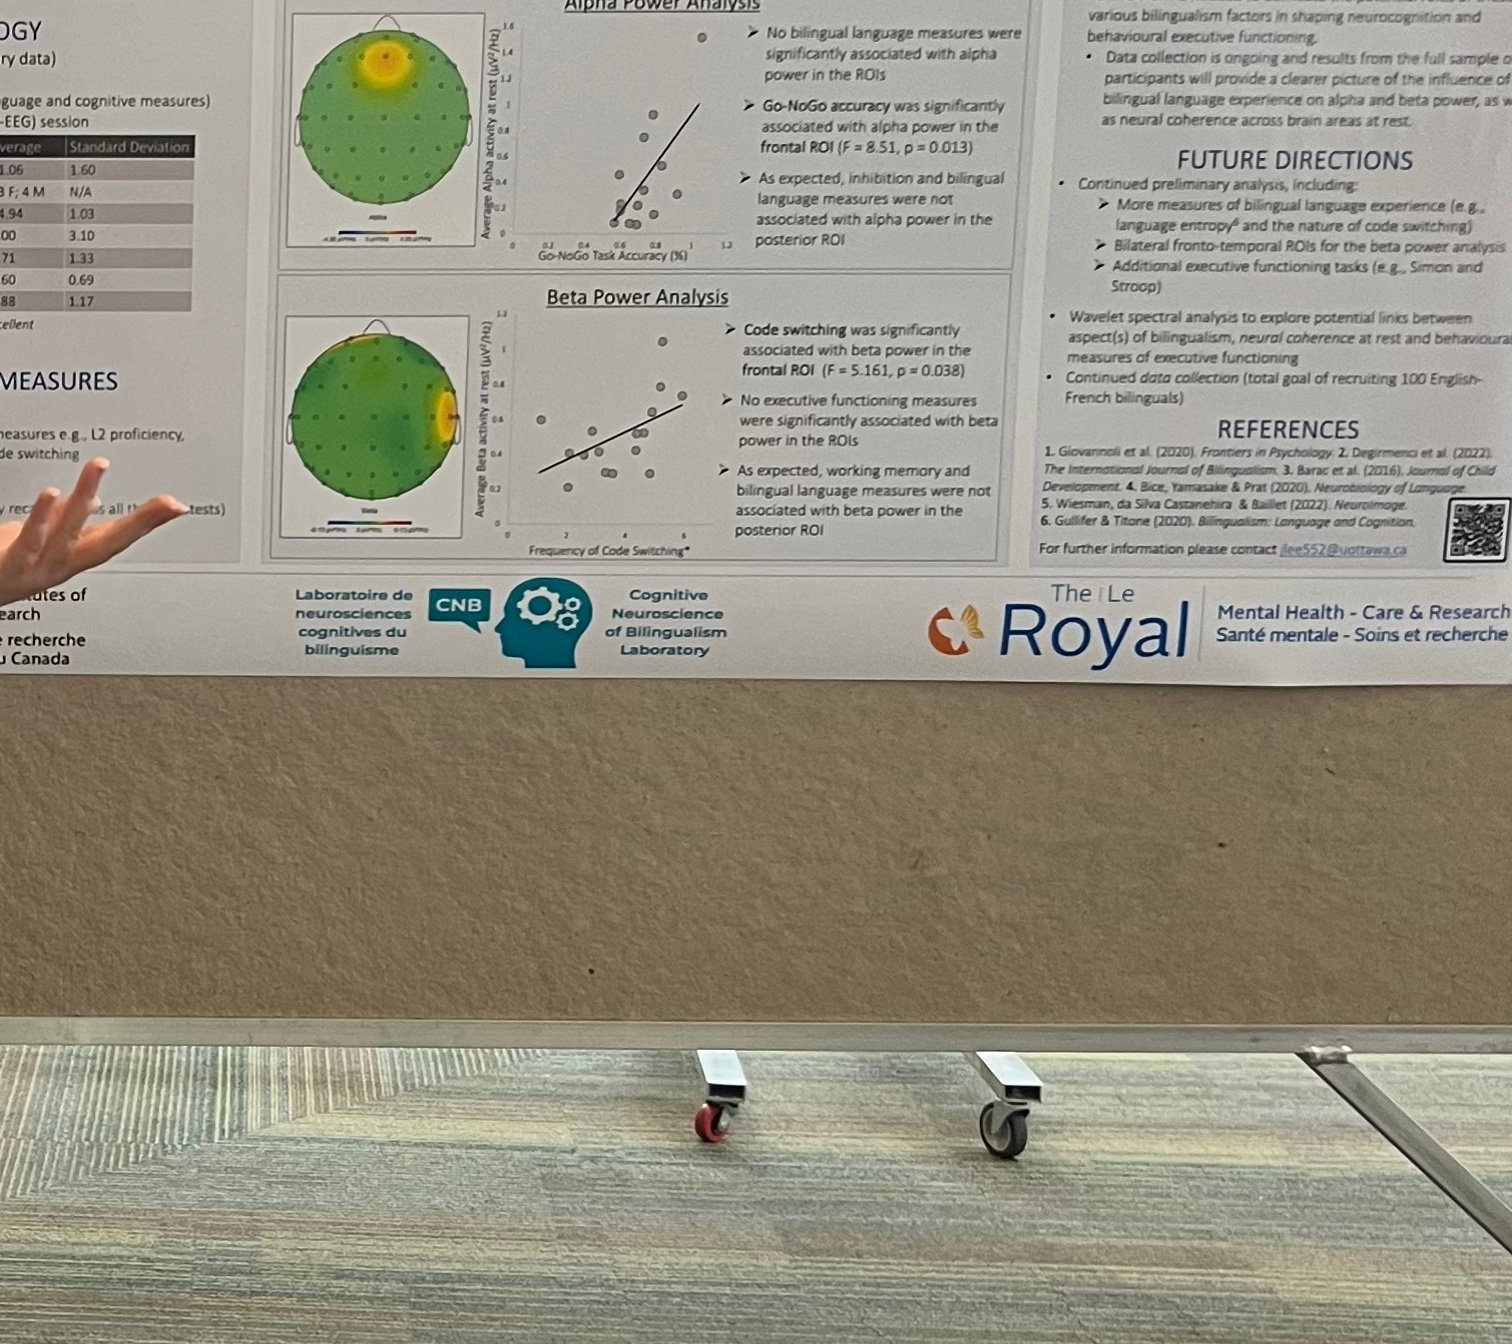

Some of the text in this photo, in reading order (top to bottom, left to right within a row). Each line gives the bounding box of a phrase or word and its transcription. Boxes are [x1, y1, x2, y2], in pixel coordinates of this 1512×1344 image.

[70, 140, 190, 153] Standard Deviation
[1178, 150, 1413, 170] FUTURE DIRECTIONS
[548, 288, 728, 307] Beta Power Analysis
[744, 323, 960, 339] Code switching was significantly
[1218, 419, 1359, 439] REFERENCES
[71, 587, 88, 602] of
[296, 589, 413, 600] Laboratoire de
[629, 589, 708, 605] Cognitive
[1051, 584, 1135, 603] The Le
[436, 598, 481, 612] CNB
[1218, 604, 1280, 620] Mental
[1286, 604, 1344, 620] Health
[1363, 605, 1404, 620] Care
[1409, 605, 1423, 620] &
[1429, 604, 1511, 620] Research
[295, 608, 412, 619] neurosciences
[612, 608, 724, 619] Neuroscience
[7, 632, 87, 647] recherche
[298, 626, 407, 641] cognitives du
[605, 626, 727, 639] of Bilingualism
[999, 601, 1189, 671] Royal
[1216, 627, 1266, 642] Santé
[1270, 627, 1339, 642] mentale
[1354, 627, 1400, 642] Soins
[1404, 628, 1421, 642] et
[1425, 626, 1509, 642] recherche
[305, 644, 399, 657] bilinguisme
[621, 645, 710, 658] Laboratory
[11, 652, 69, 665] Canada
